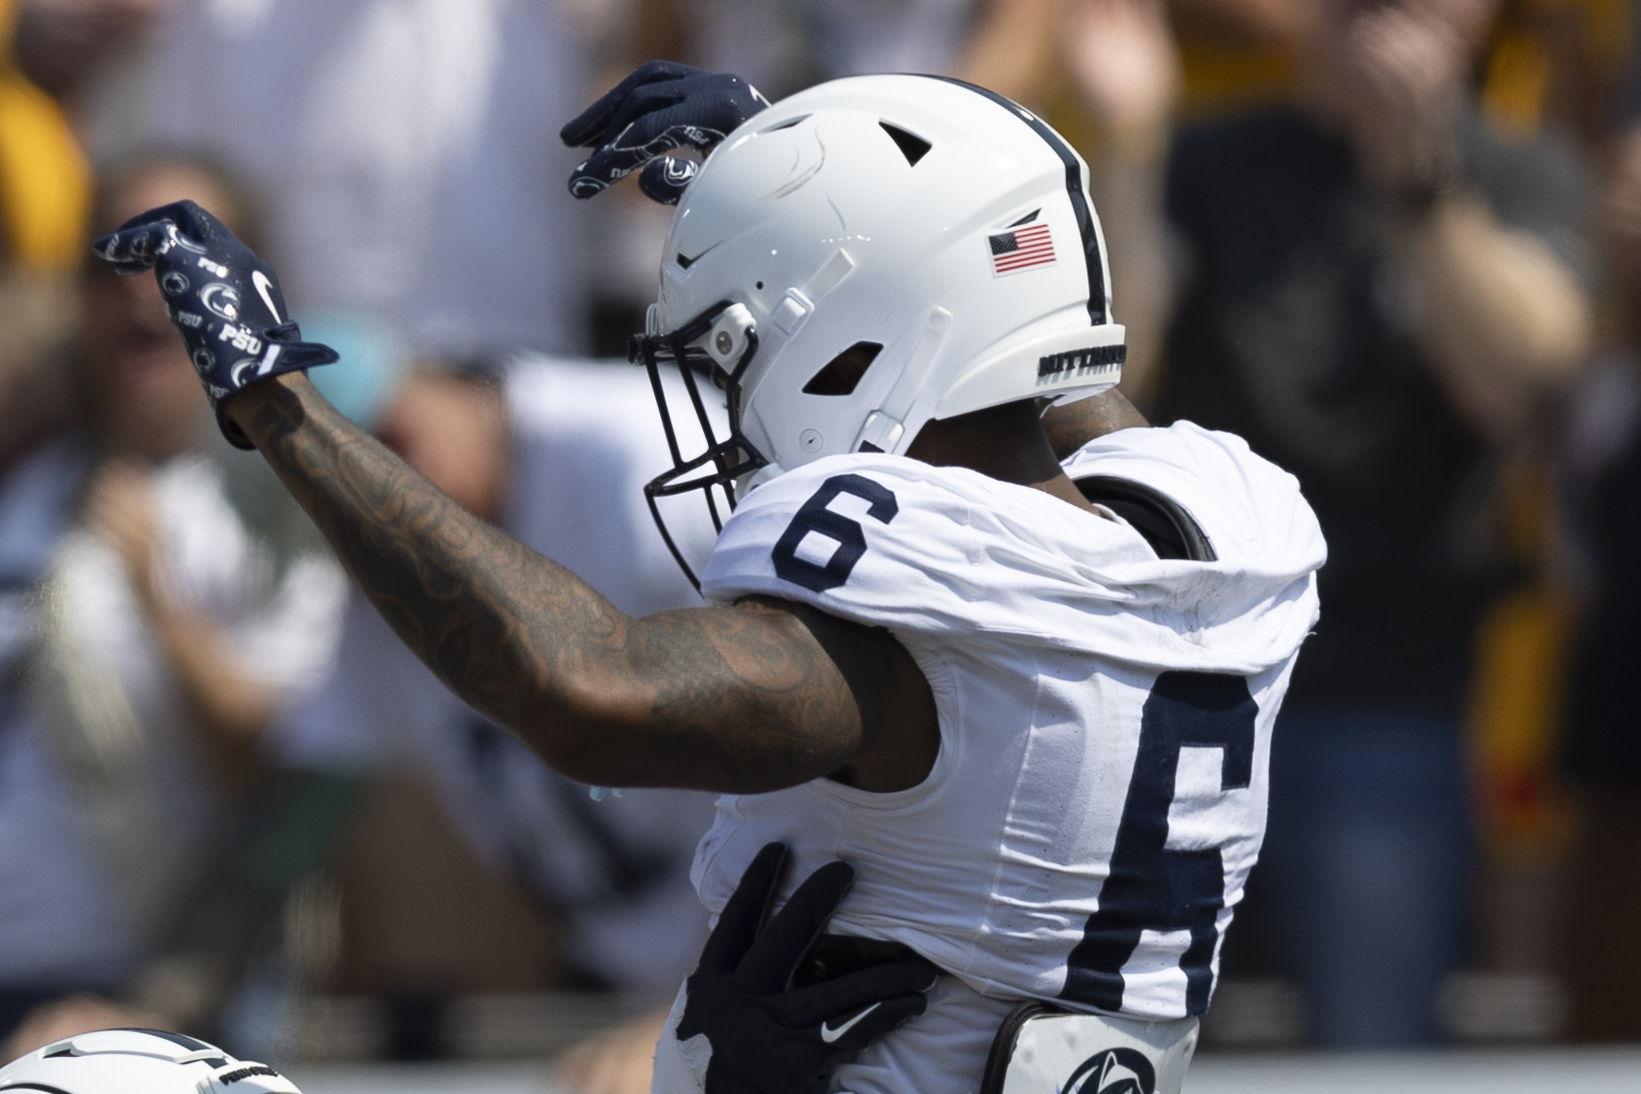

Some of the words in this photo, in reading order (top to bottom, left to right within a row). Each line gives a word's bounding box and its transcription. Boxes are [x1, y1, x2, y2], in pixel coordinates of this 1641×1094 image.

[218, 323, 261, 355] PSU
[770, 472, 899, 594] 6
[1057, 670, 1260, 1018] 6
